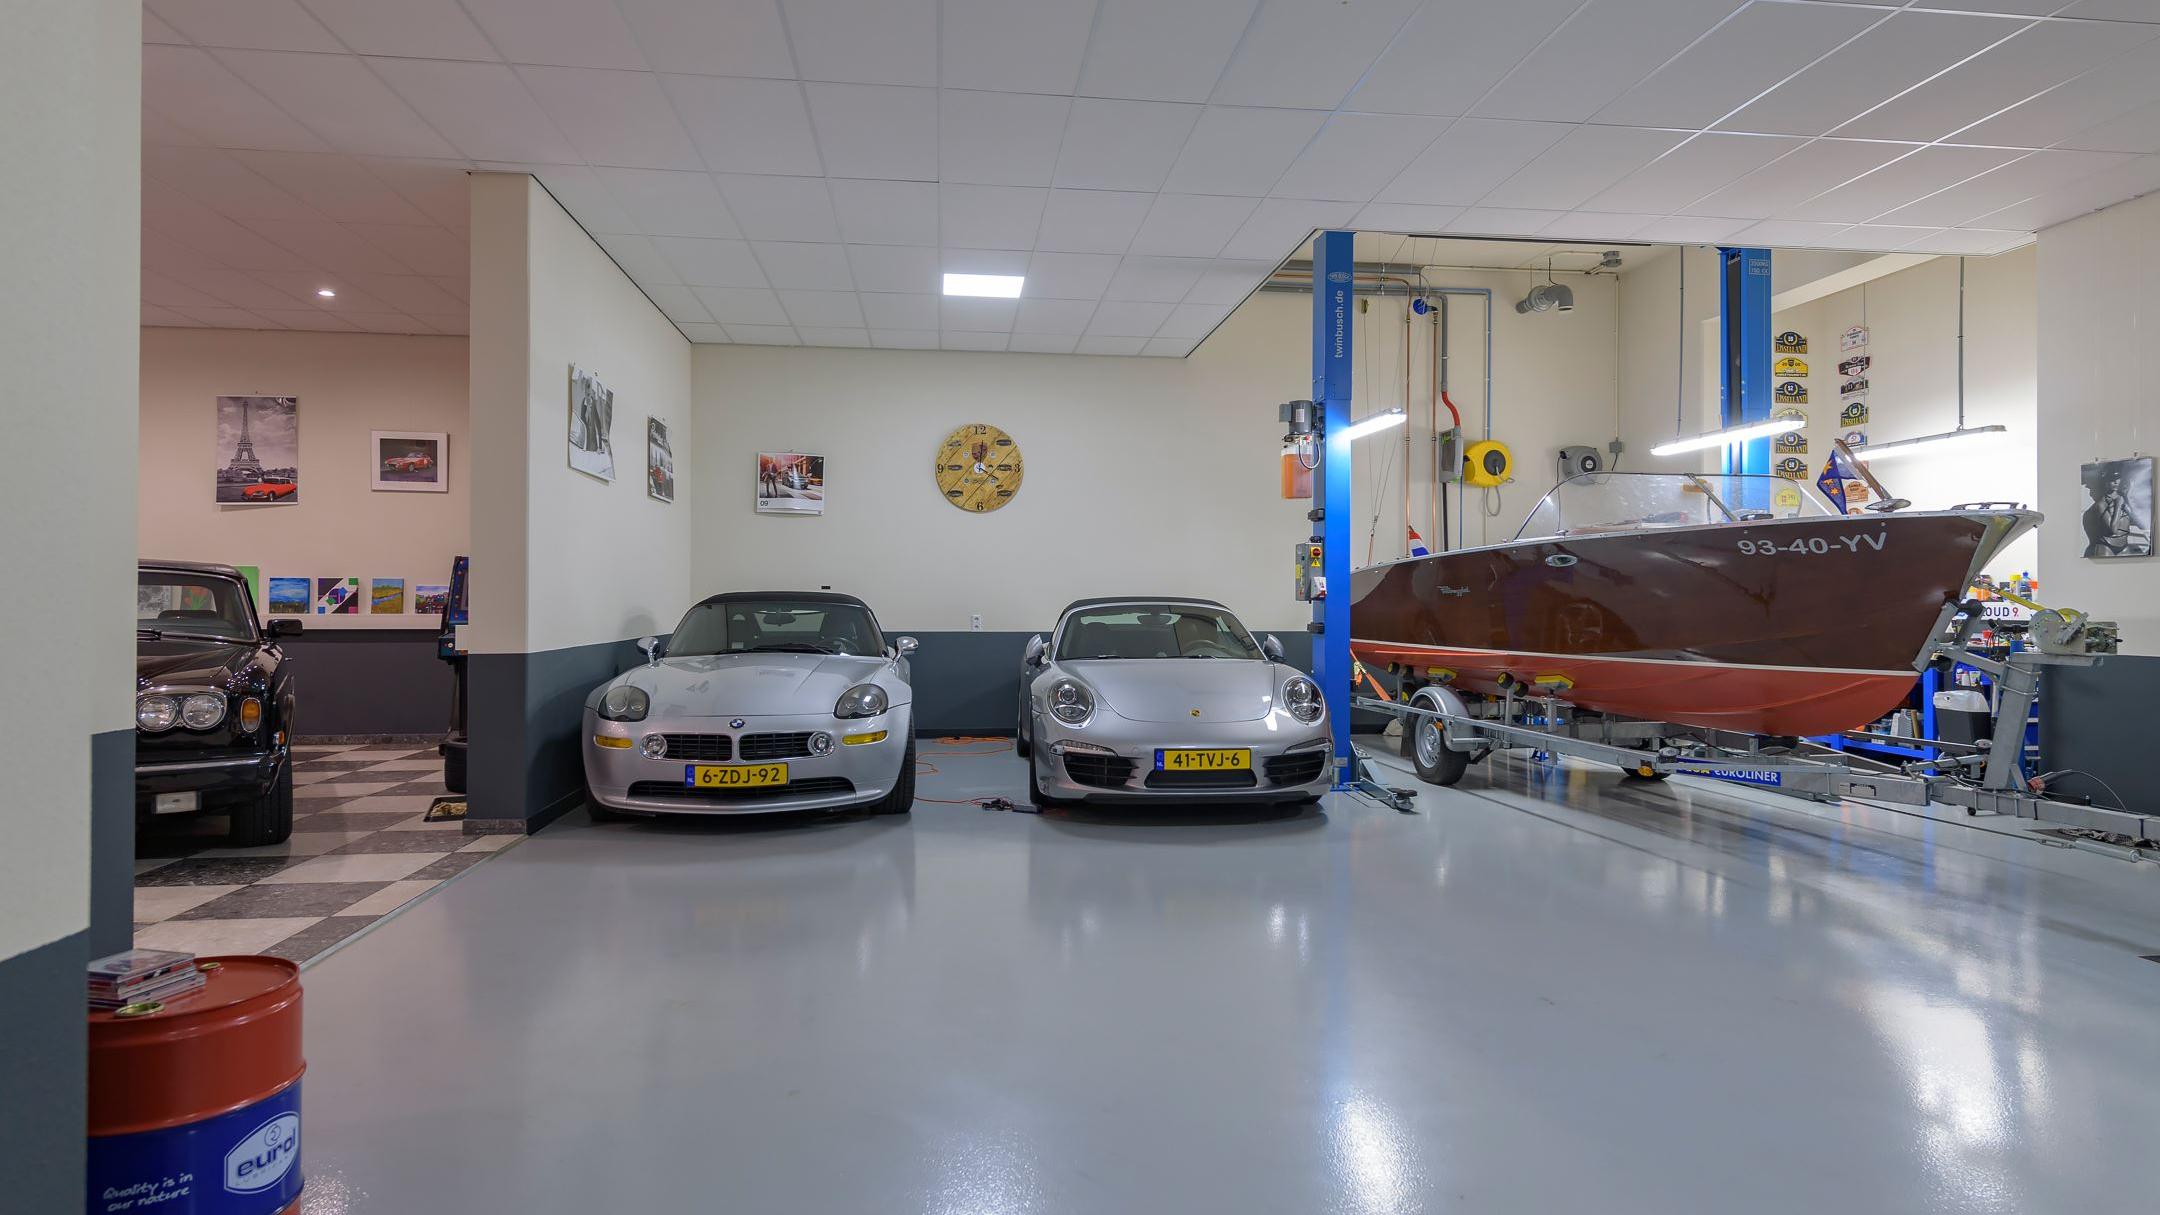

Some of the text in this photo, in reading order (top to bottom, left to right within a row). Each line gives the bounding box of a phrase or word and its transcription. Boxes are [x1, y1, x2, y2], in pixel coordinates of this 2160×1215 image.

[1334, 290, 1344, 358] twinbusch.de
[974, 425, 987, 435] 12
[937, 463, 944, 473] 9
[1015, 463, 1021, 473] 3
[976, 501, 983, 511] 6
[1737, 531, 1887, 555] 93-40-YV
[1983, 606, 2010, 617] OUD
[1173, 752, 1241, 767] 41-TVJ-6
[702, 767, 780, 784] 6-ZDJ-92
[237, 1127, 296, 1177] eurol
[103, 1173, 193, 1199] Quality is in
[107, 1187, 190, 1212] our nature
